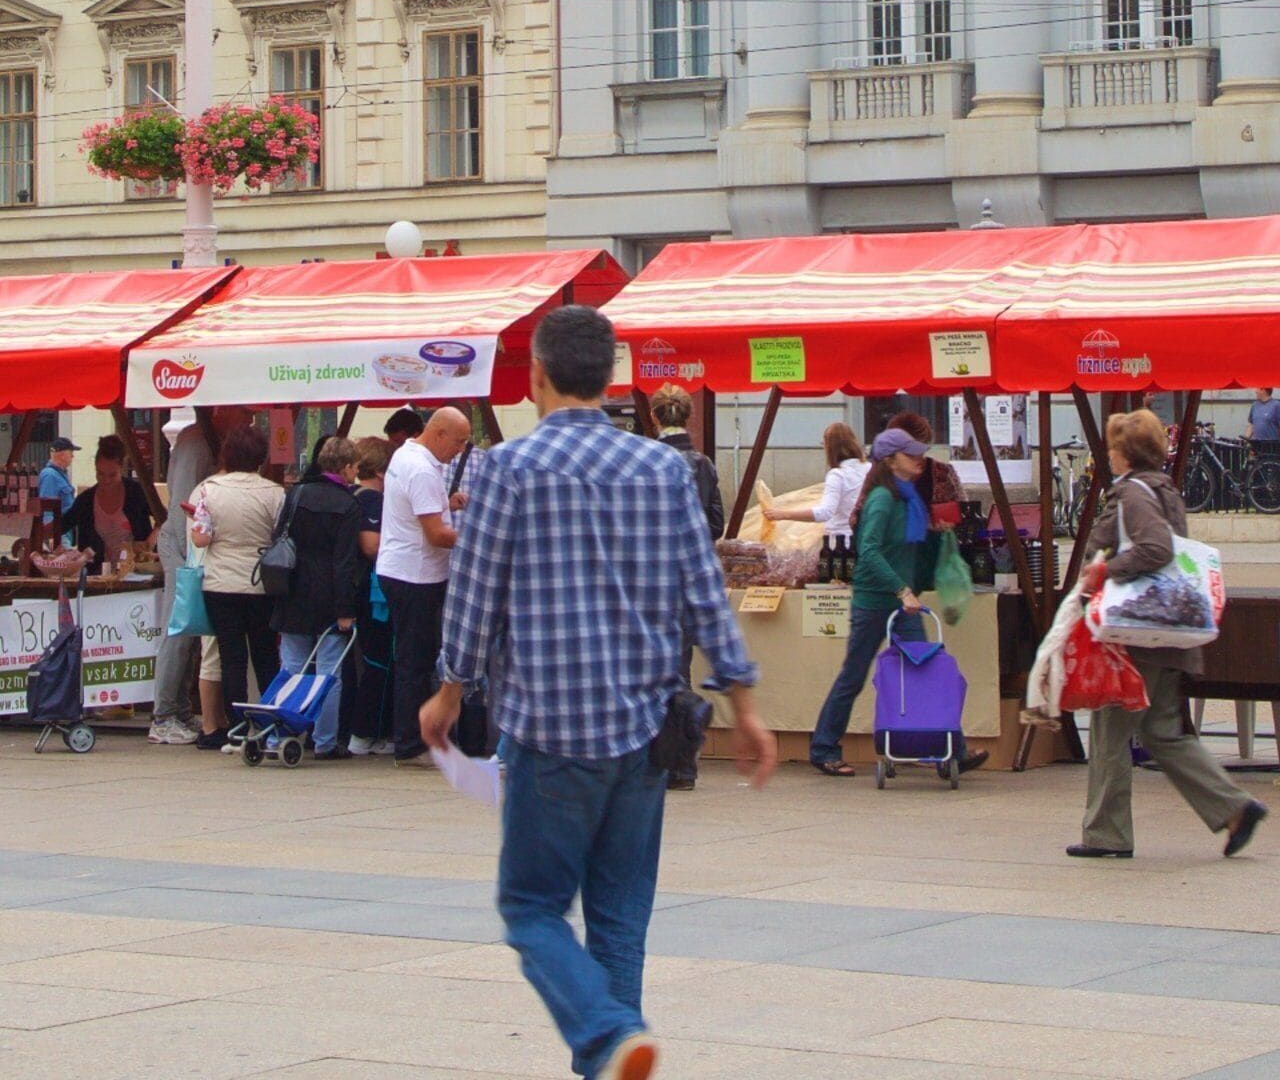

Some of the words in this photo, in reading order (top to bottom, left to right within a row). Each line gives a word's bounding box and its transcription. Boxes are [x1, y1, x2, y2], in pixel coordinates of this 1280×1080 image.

[269, 364, 311, 384] Uživaj
[316, 363, 366, 380] zdravo!
[639, 360, 676, 378] tržnice
[1077, 355, 1119, 374] tržnice
[155, 366, 198, 390] Sana
[14, 610, 123, 653] Bloom
[87, 662, 117, 682] vsak
[123, 660, 153, 680] žep!
